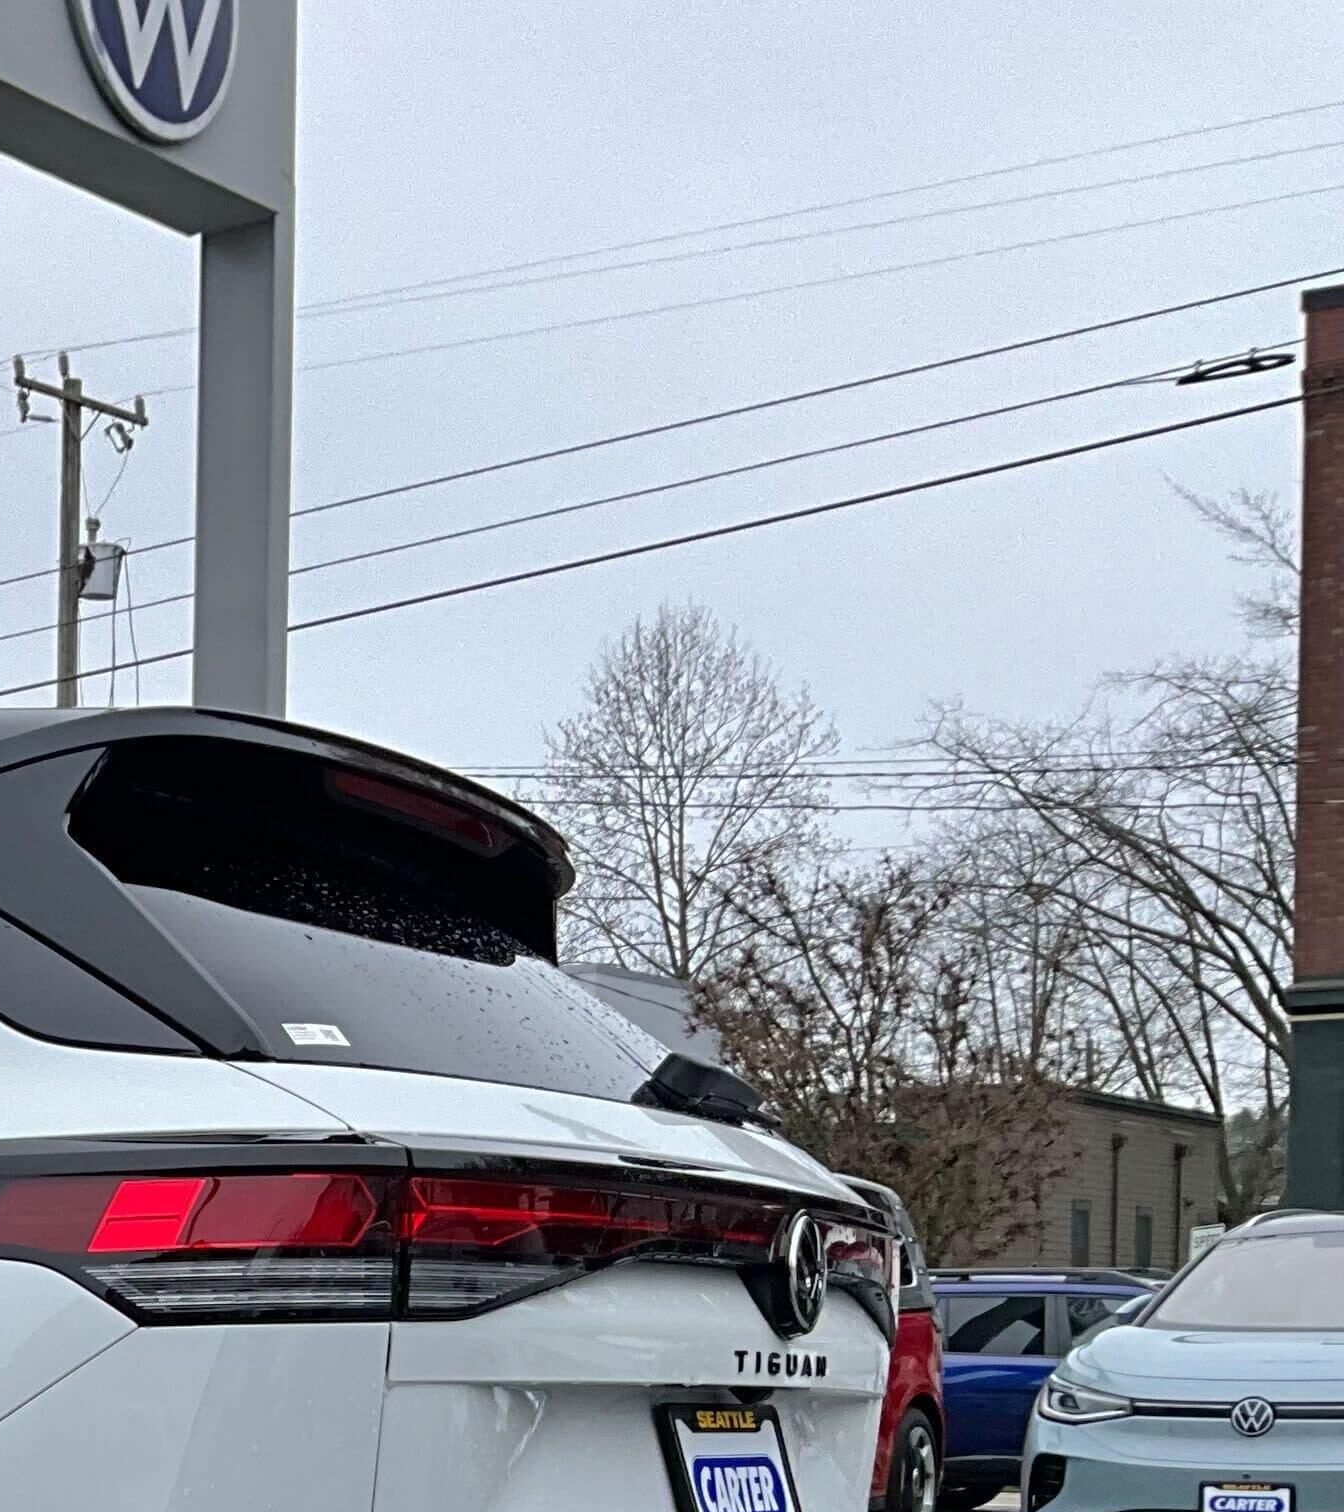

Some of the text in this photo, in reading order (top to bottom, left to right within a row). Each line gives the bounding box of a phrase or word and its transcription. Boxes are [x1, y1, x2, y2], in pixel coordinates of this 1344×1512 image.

[734, 1350, 828, 1378] TIGUAN
[695, 1410, 757, 1430] SEATTLE
[1214, 1497, 1279, 1512] CARTER
